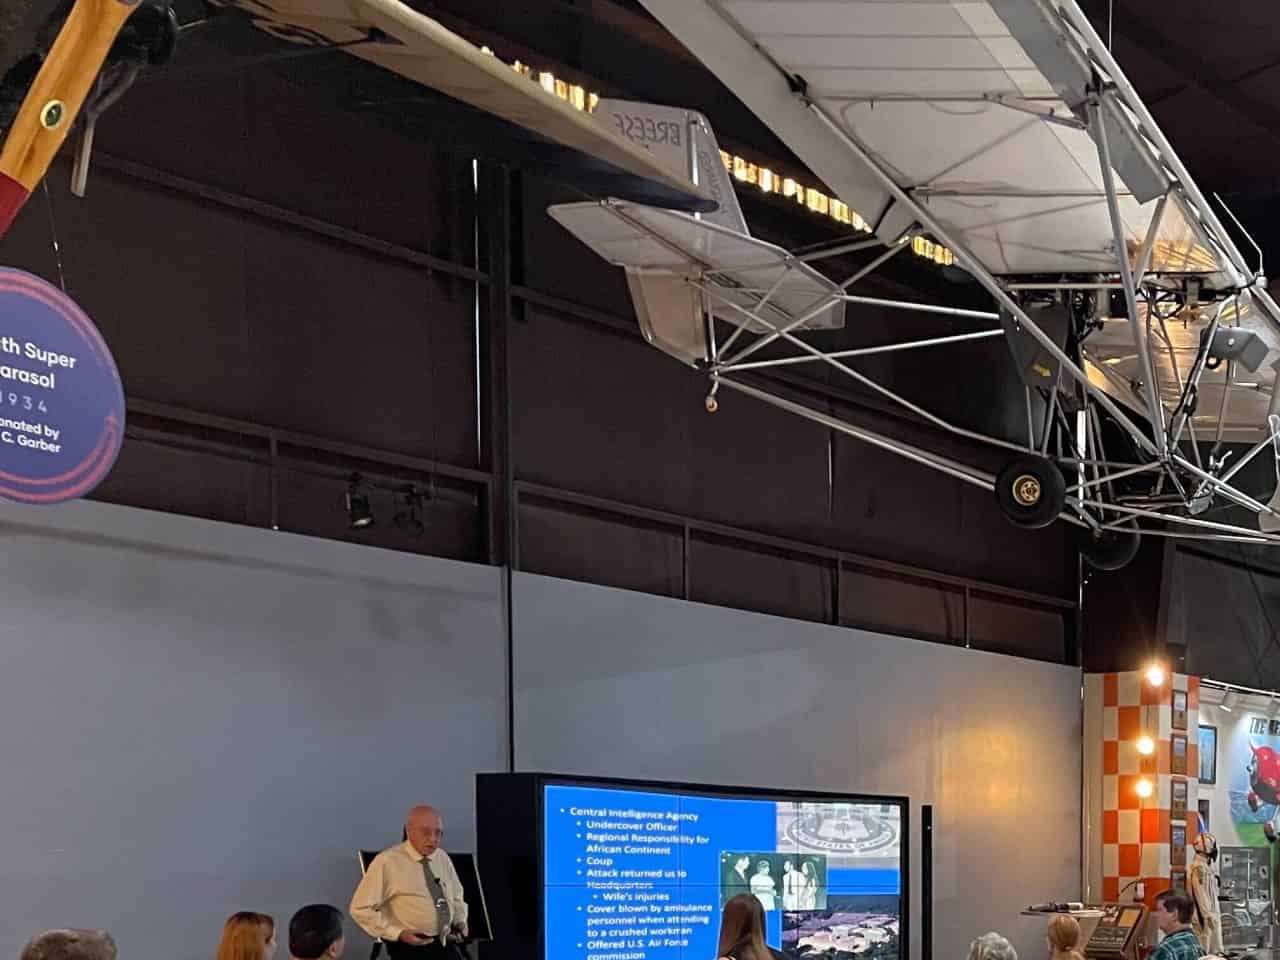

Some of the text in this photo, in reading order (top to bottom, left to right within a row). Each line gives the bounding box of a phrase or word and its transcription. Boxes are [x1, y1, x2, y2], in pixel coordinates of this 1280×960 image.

[0, 336, 76, 368] th Super
[0, 366, 55, 389] arasol
[0, 418, 60, 440] onated by
[17, 435, 61, 453] Garber
[570, 807, 699, 822] Central Intelligence Agency
[586, 820, 677, 831] Undercover Officer
[586, 832, 710, 844] Regional Responsibility for
[586, 844, 671, 855] African Continent
[586, 857, 613, 867] Coup
[586, 869, 687, 878] Attack returned us to
[587, 881, 654, 891] Headquarters
[602, 892, 670, 902] Wife's injuries
[587, 903, 712, 914] Cover blown by ambulance
[587, 915, 709, 926] personnel when attending
[587, 929, 598, 937] to
[609, 928, 648, 937] crushed
[650, 927, 693, 936] workman
[587, 940, 625, 950] Offered
[648, 938, 661, 947] Air
[664, 938, 689, 947] Force
[587, 952, 646, 960] commission
